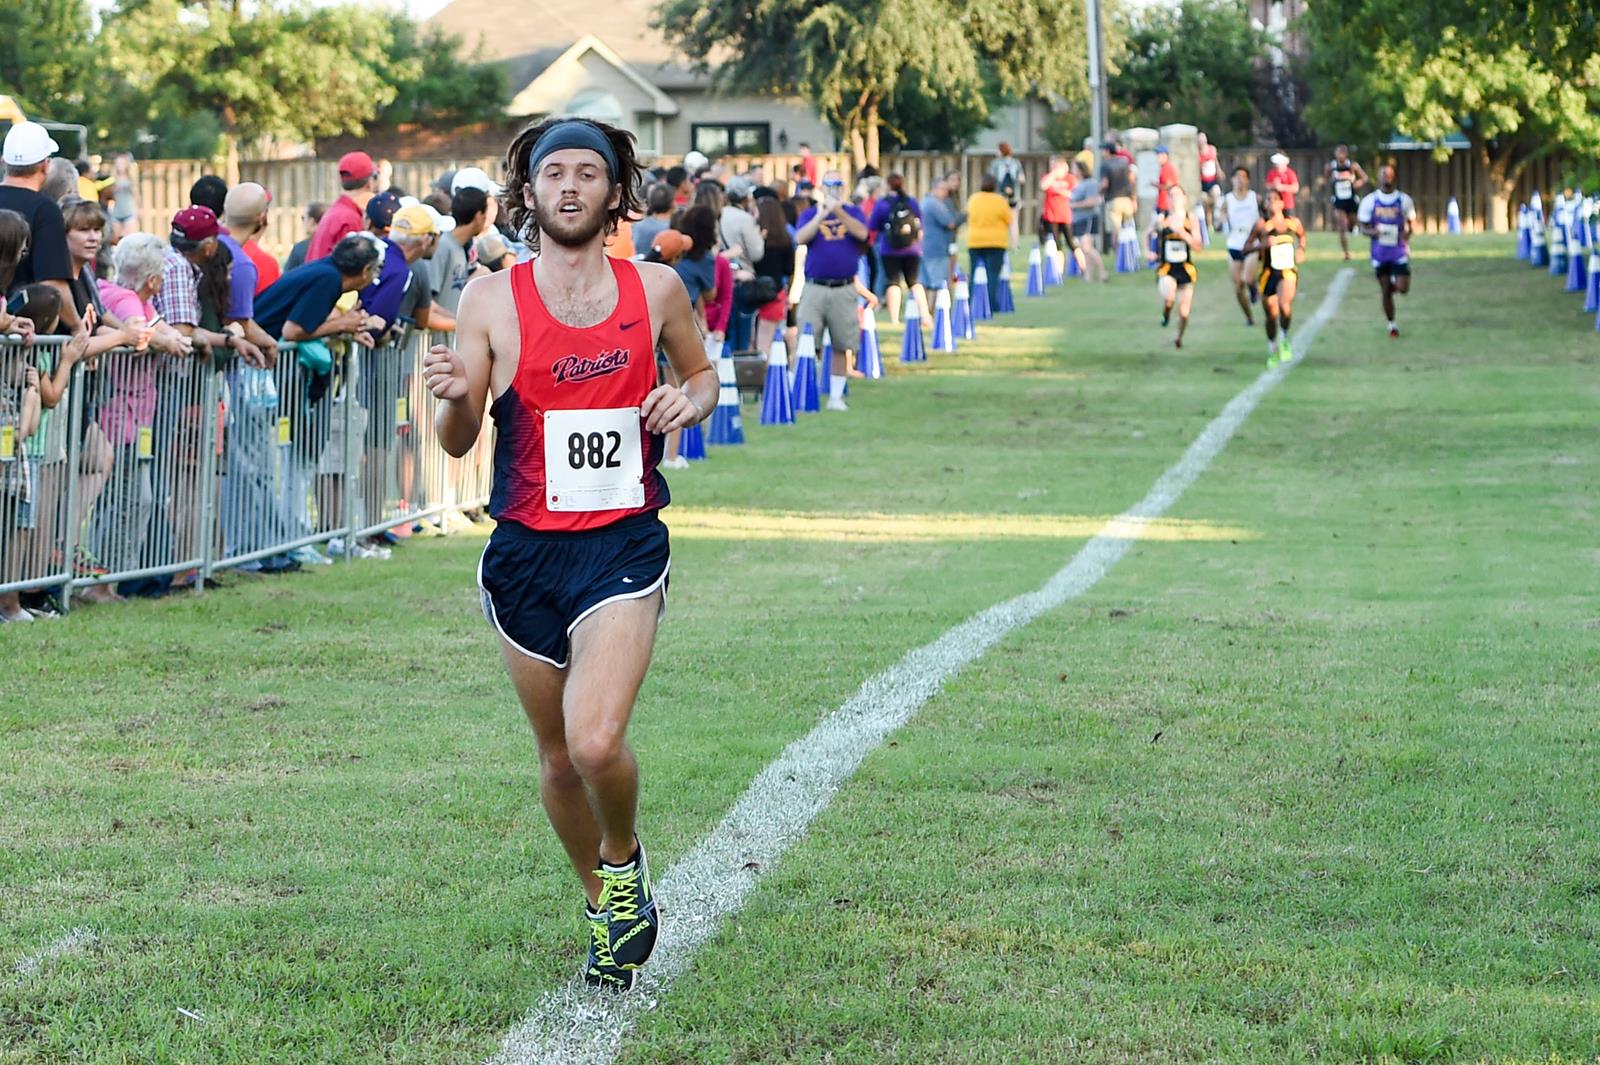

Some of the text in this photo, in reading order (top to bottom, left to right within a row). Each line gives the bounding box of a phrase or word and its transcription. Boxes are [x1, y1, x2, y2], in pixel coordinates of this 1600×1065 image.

[552, 349, 630, 387] Patriots
[568, 430, 621, 470] 882
[612, 920, 650, 952] BROOKS
